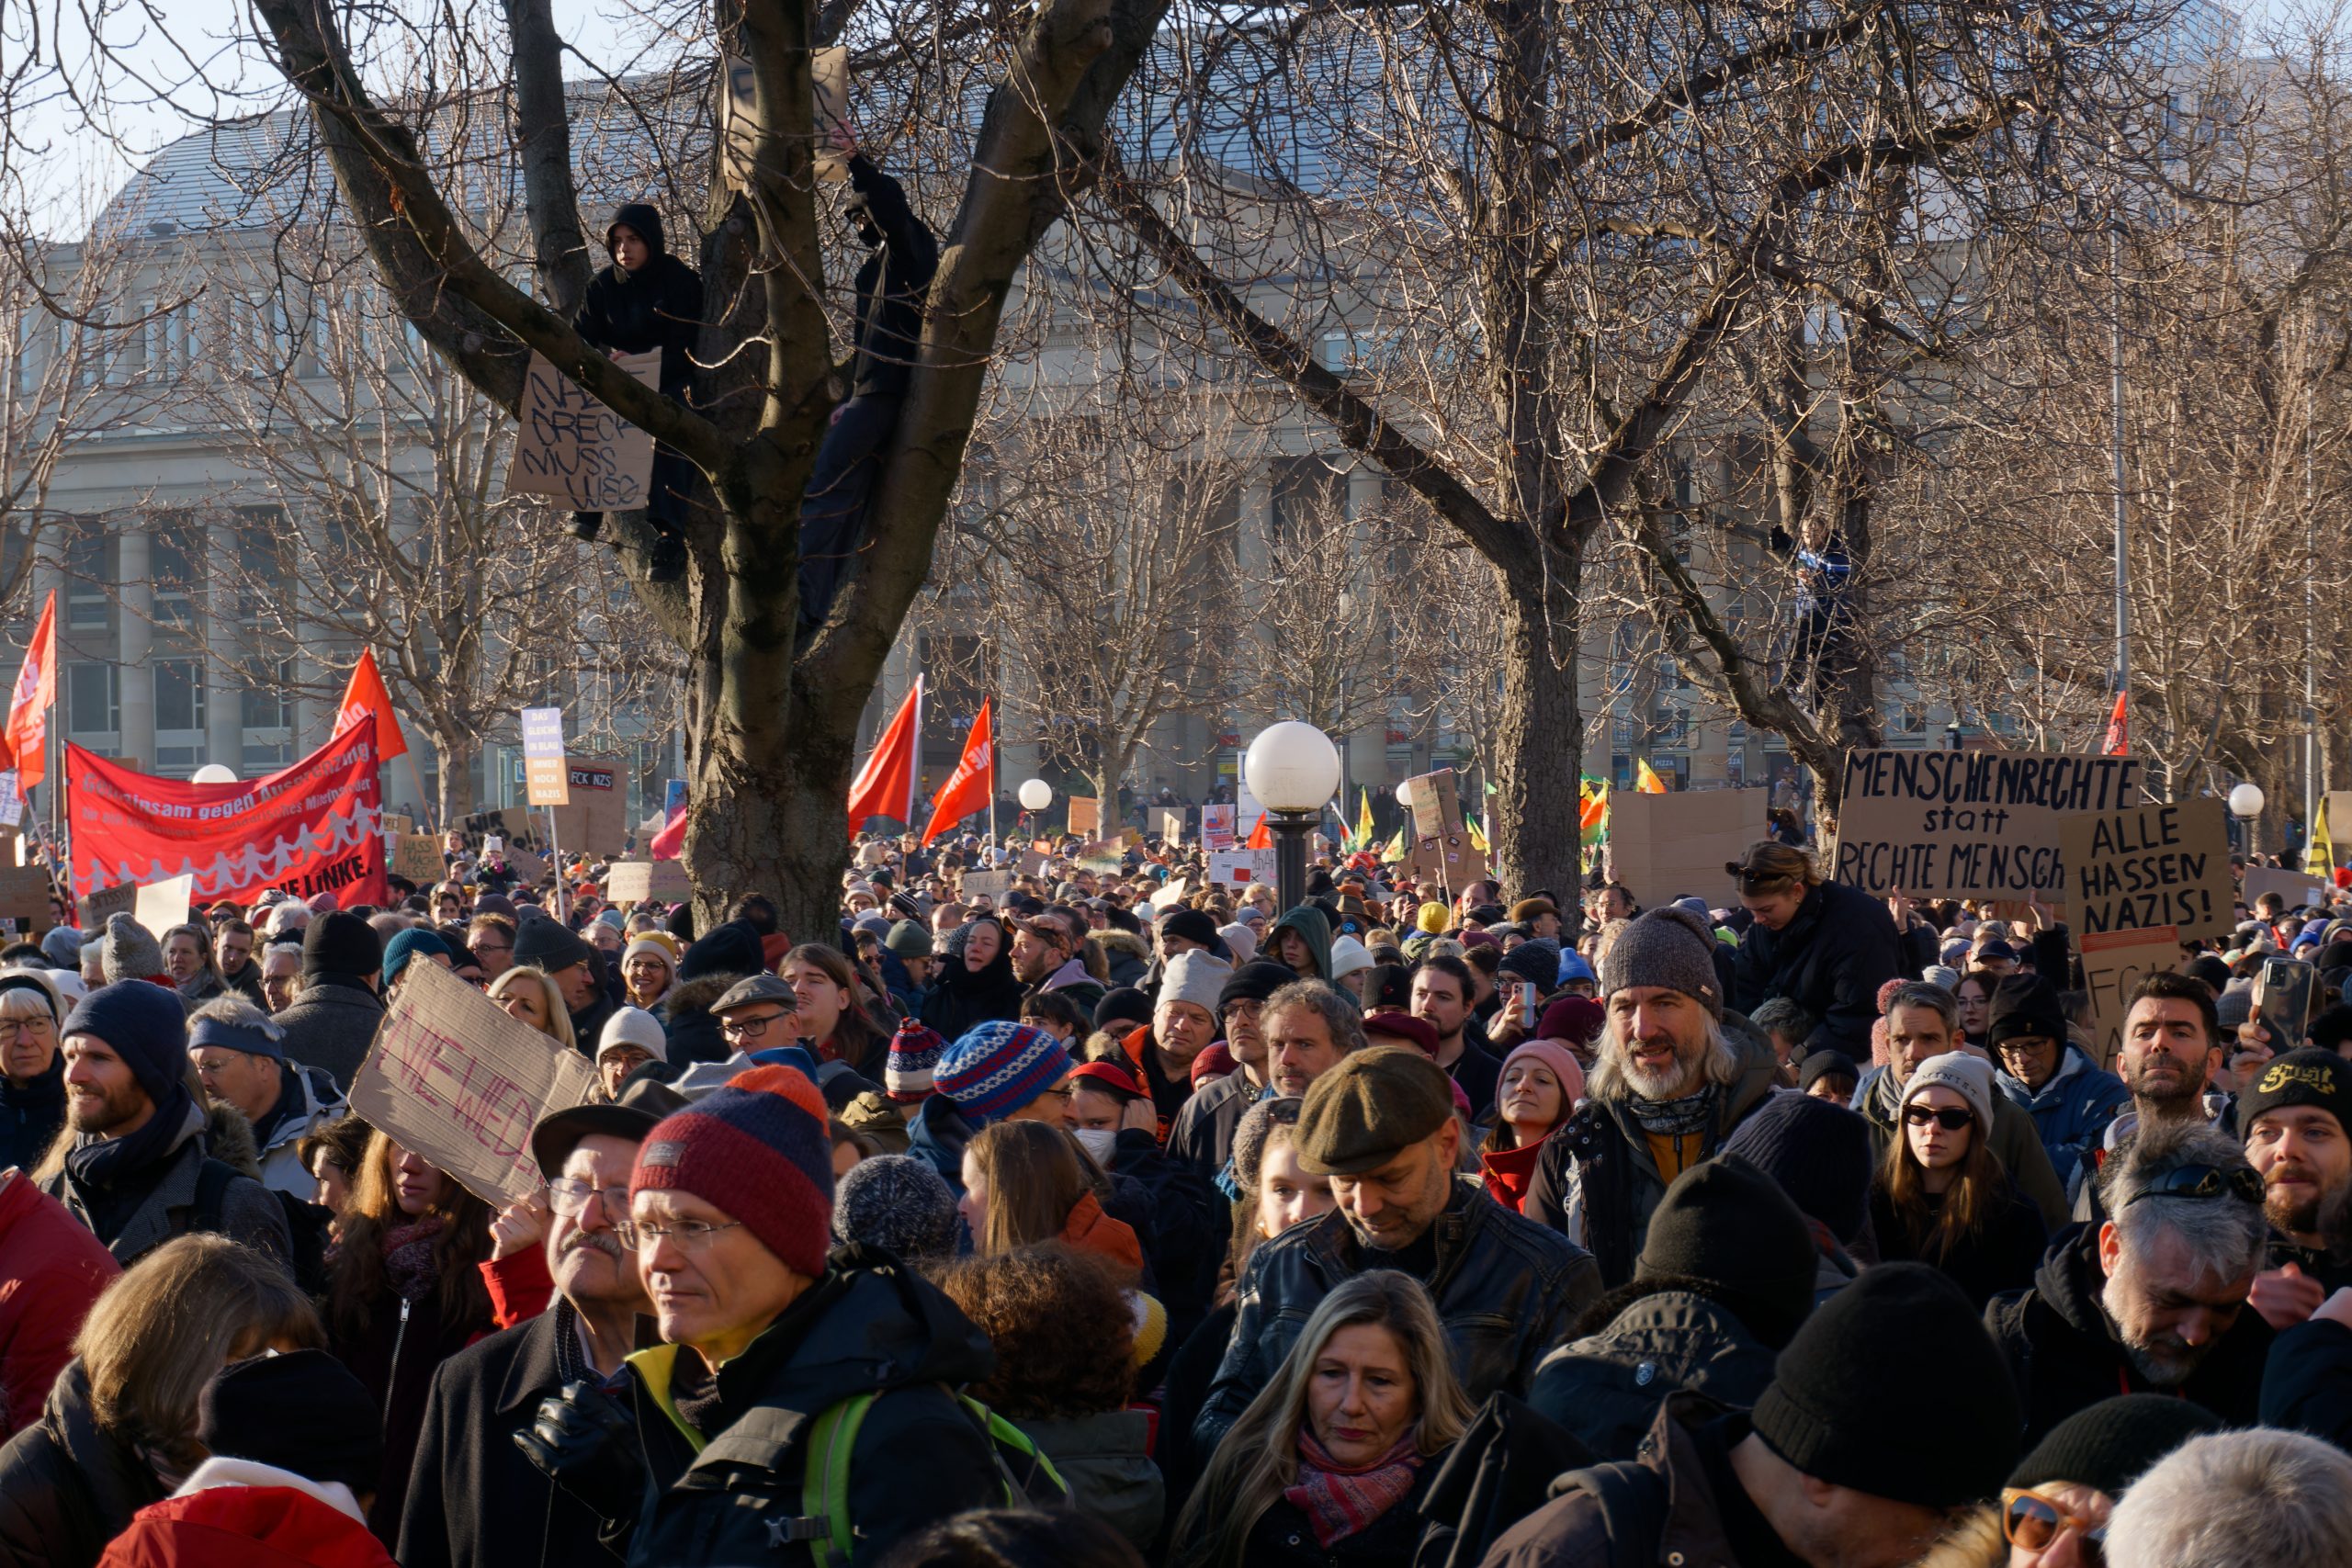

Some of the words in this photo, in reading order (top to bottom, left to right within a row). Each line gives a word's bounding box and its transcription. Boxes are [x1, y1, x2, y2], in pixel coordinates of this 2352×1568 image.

[532, 408, 639, 447] DRECK
[523, 446, 617, 476] MUSS
[565, 474, 640, 511] WEG
[531, 712, 548, 721] DAS
[528, 742, 537, 751] IN
[1654, 759, 1675, 767] PIZZA
[1727, 758, 1743, 766] ZZA
[534, 774, 558, 784] NOCH
[571, 772, 589, 784] FCK
[593, 773, 612, 787] NZS
[1842, 751, 2139, 810] MENSCHENRECHTE
[198, 792, 255, 820] gegen
[536, 789, 561, 799] NAZIS
[465, 811, 504, 832] WIR
[1923, 805, 2010, 834] statt
[2091, 807, 2180, 858] ALLE
[1838, 840, 1937, 892] RECHTE
[2081, 852, 2207, 900] HASSEN
[2085, 888, 2212, 934] NAZIS!
[2088, 963, 2176, 1019] FC
[375, 1003, 466, 1108] NIE
[453, 1056, 546, 1185] WIED
